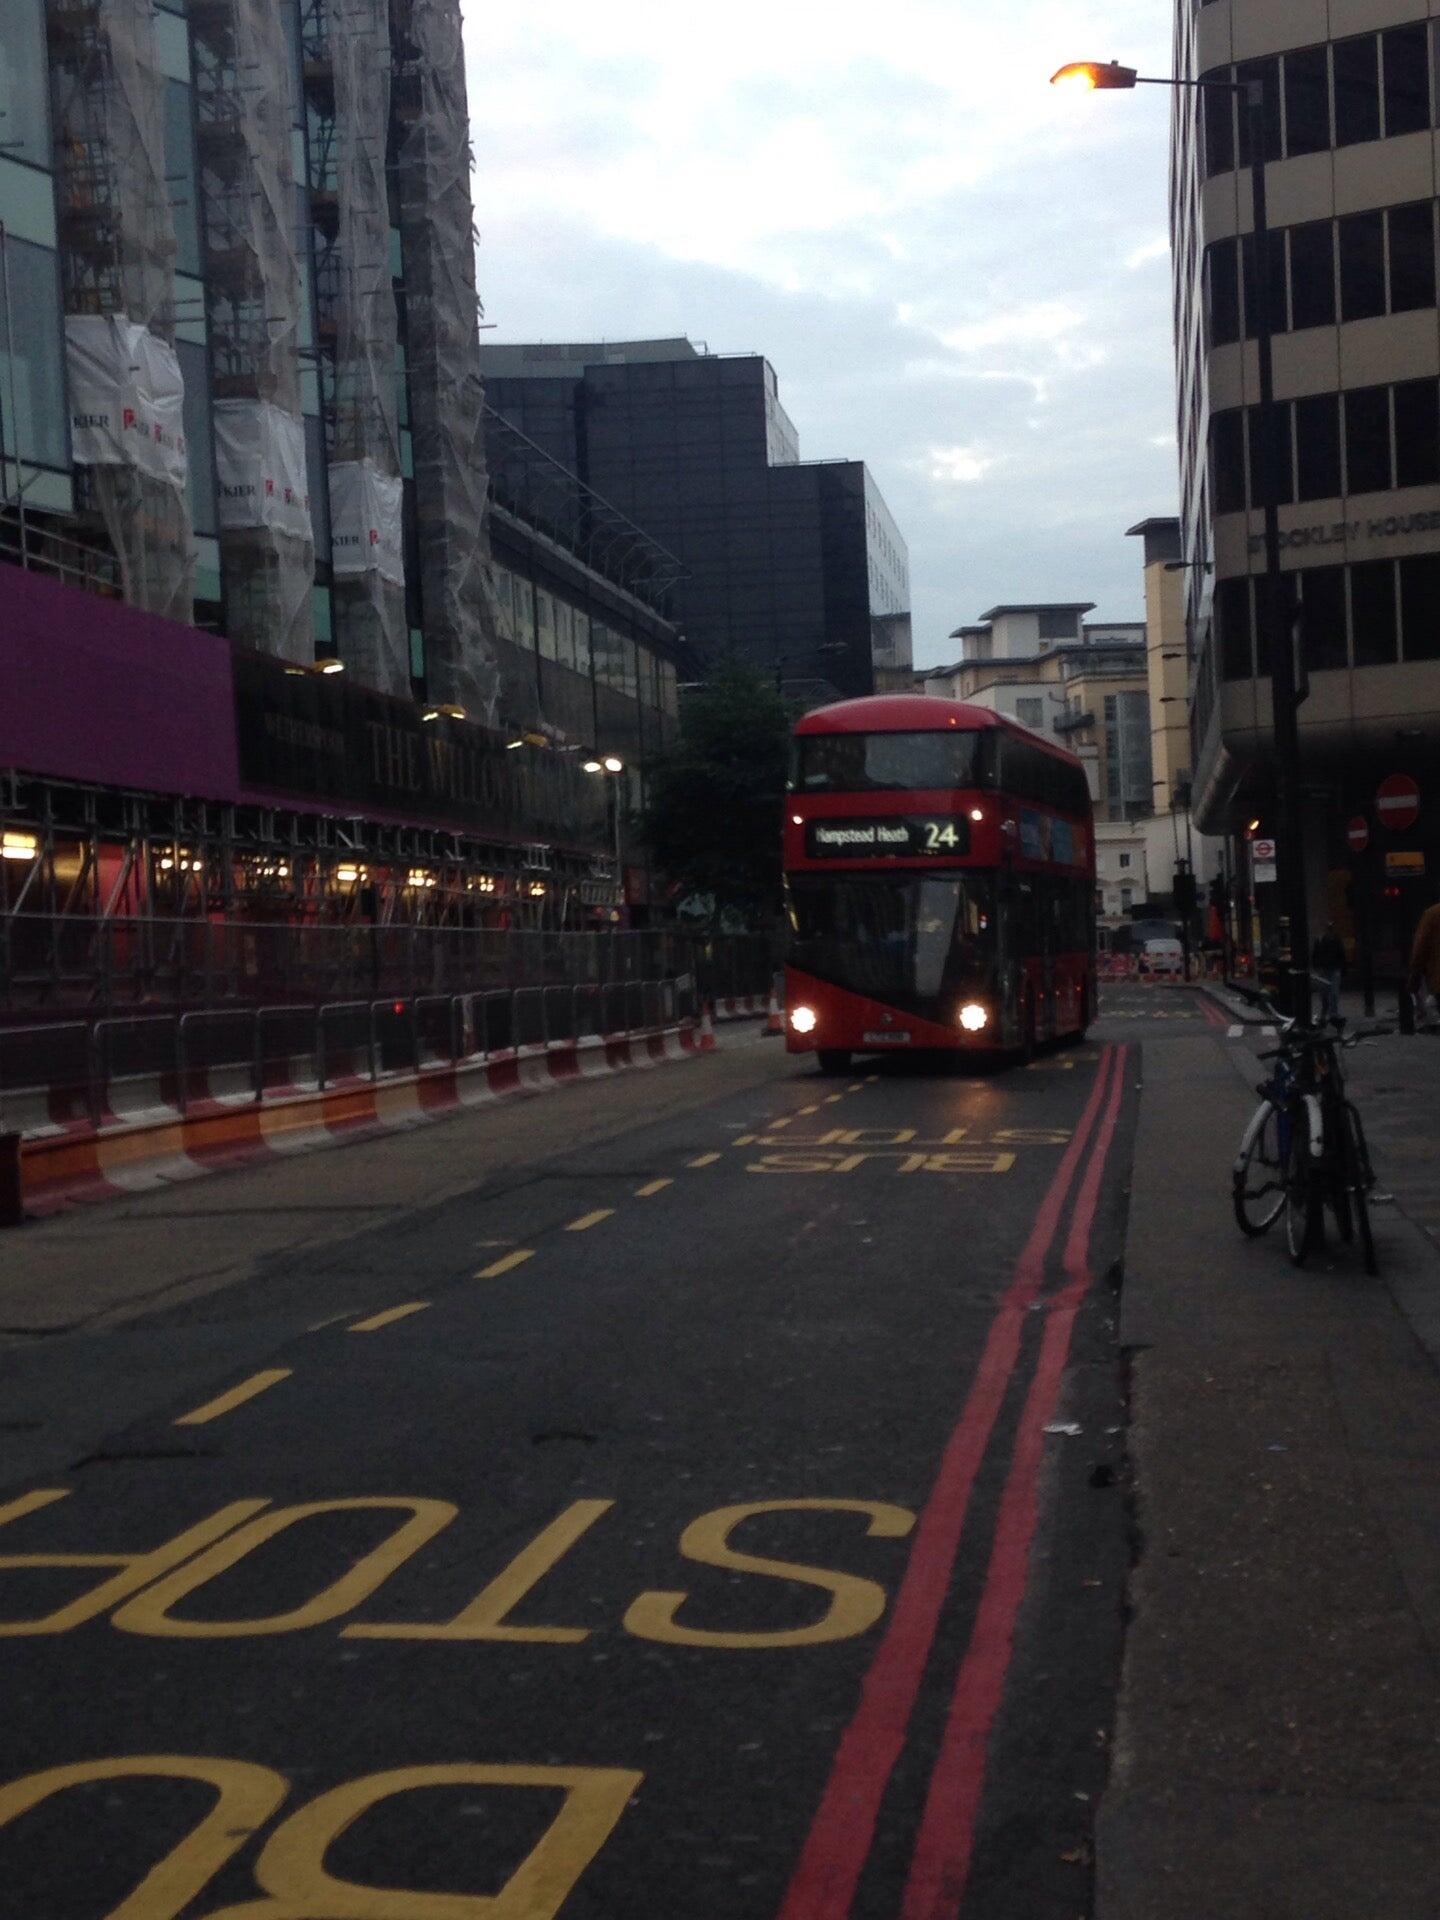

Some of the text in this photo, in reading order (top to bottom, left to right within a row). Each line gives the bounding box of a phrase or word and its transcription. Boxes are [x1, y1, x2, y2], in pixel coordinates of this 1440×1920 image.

[815, 822, 960, 848] Hampstead Heath 24
[746, 1151, 1017, 1173] BUS
